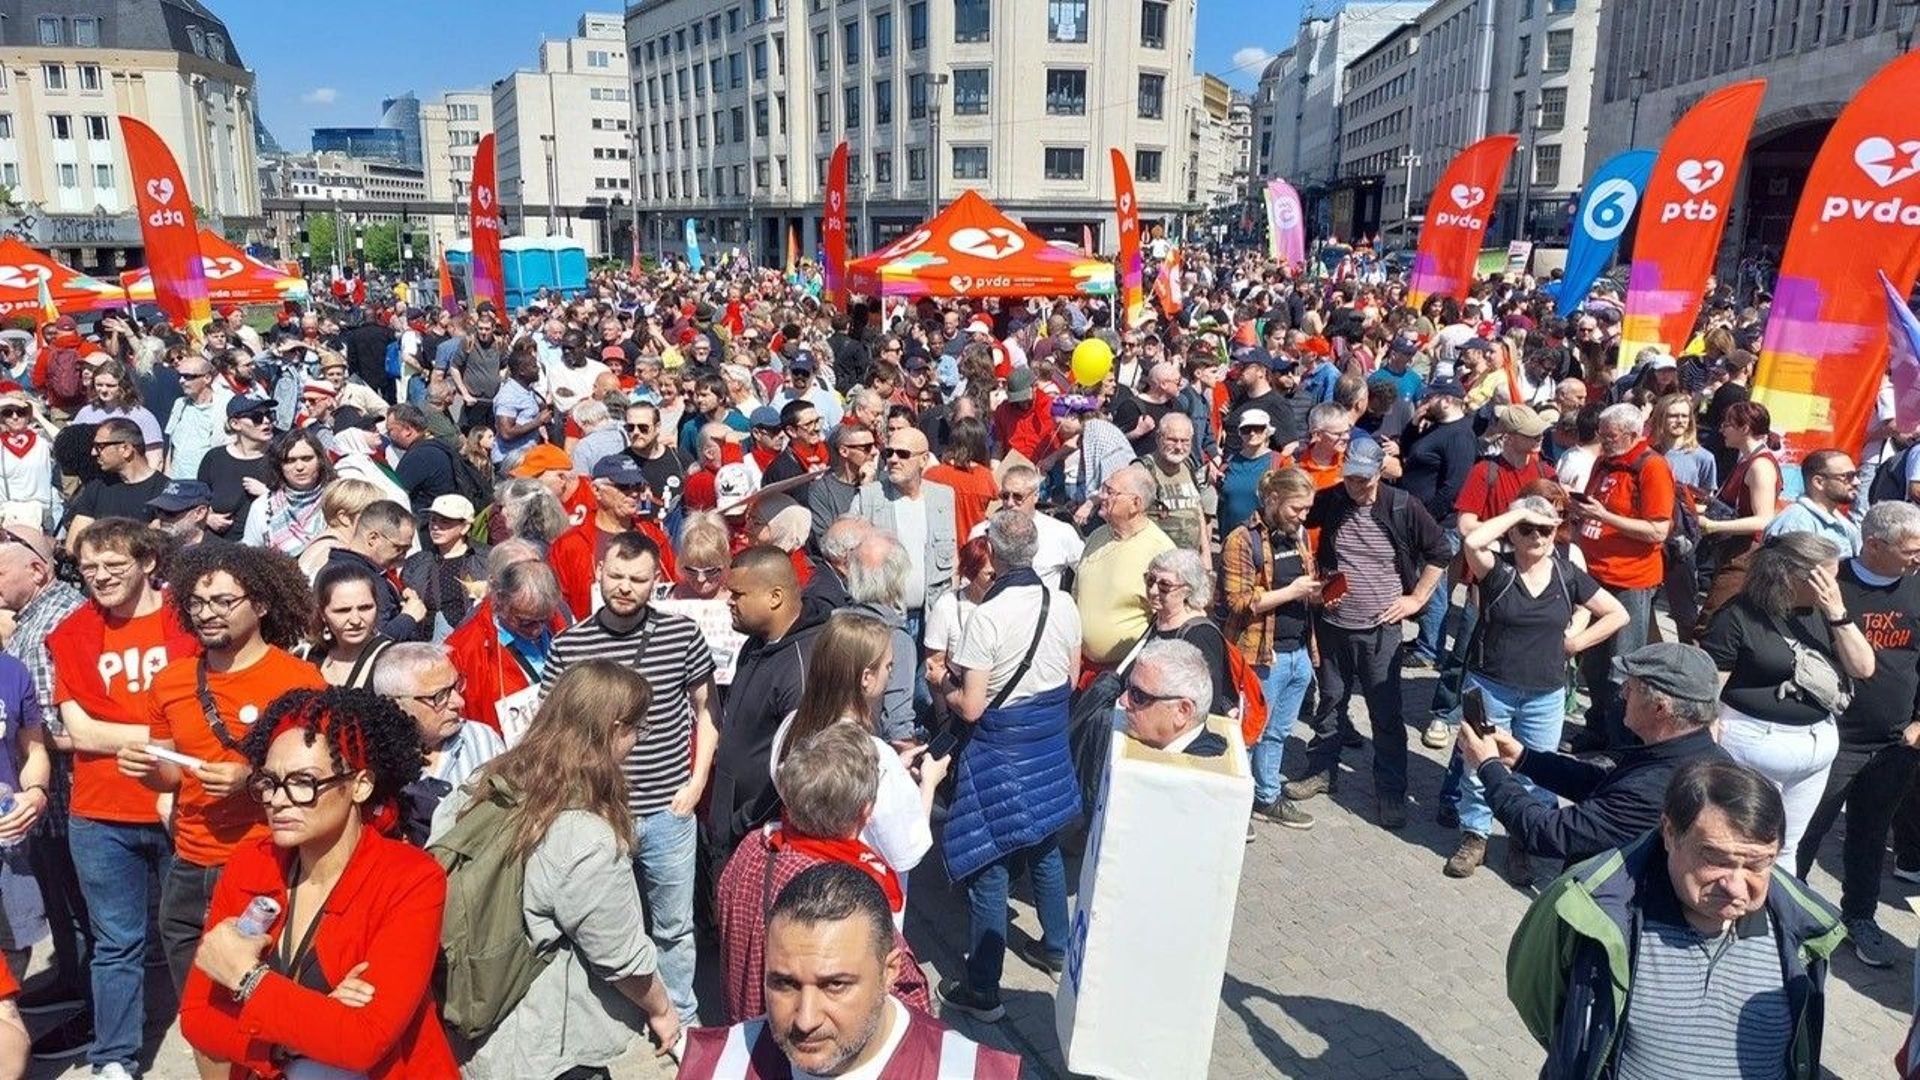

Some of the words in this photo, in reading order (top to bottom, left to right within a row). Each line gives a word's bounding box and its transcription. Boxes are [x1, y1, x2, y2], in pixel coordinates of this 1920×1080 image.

[1592, 190, 1626, 229] 6
[1661, 198, 1718, 224] ptb
[1436, 212, 1481, 230] pvda
[975, 276, 1011, 288] pvda
